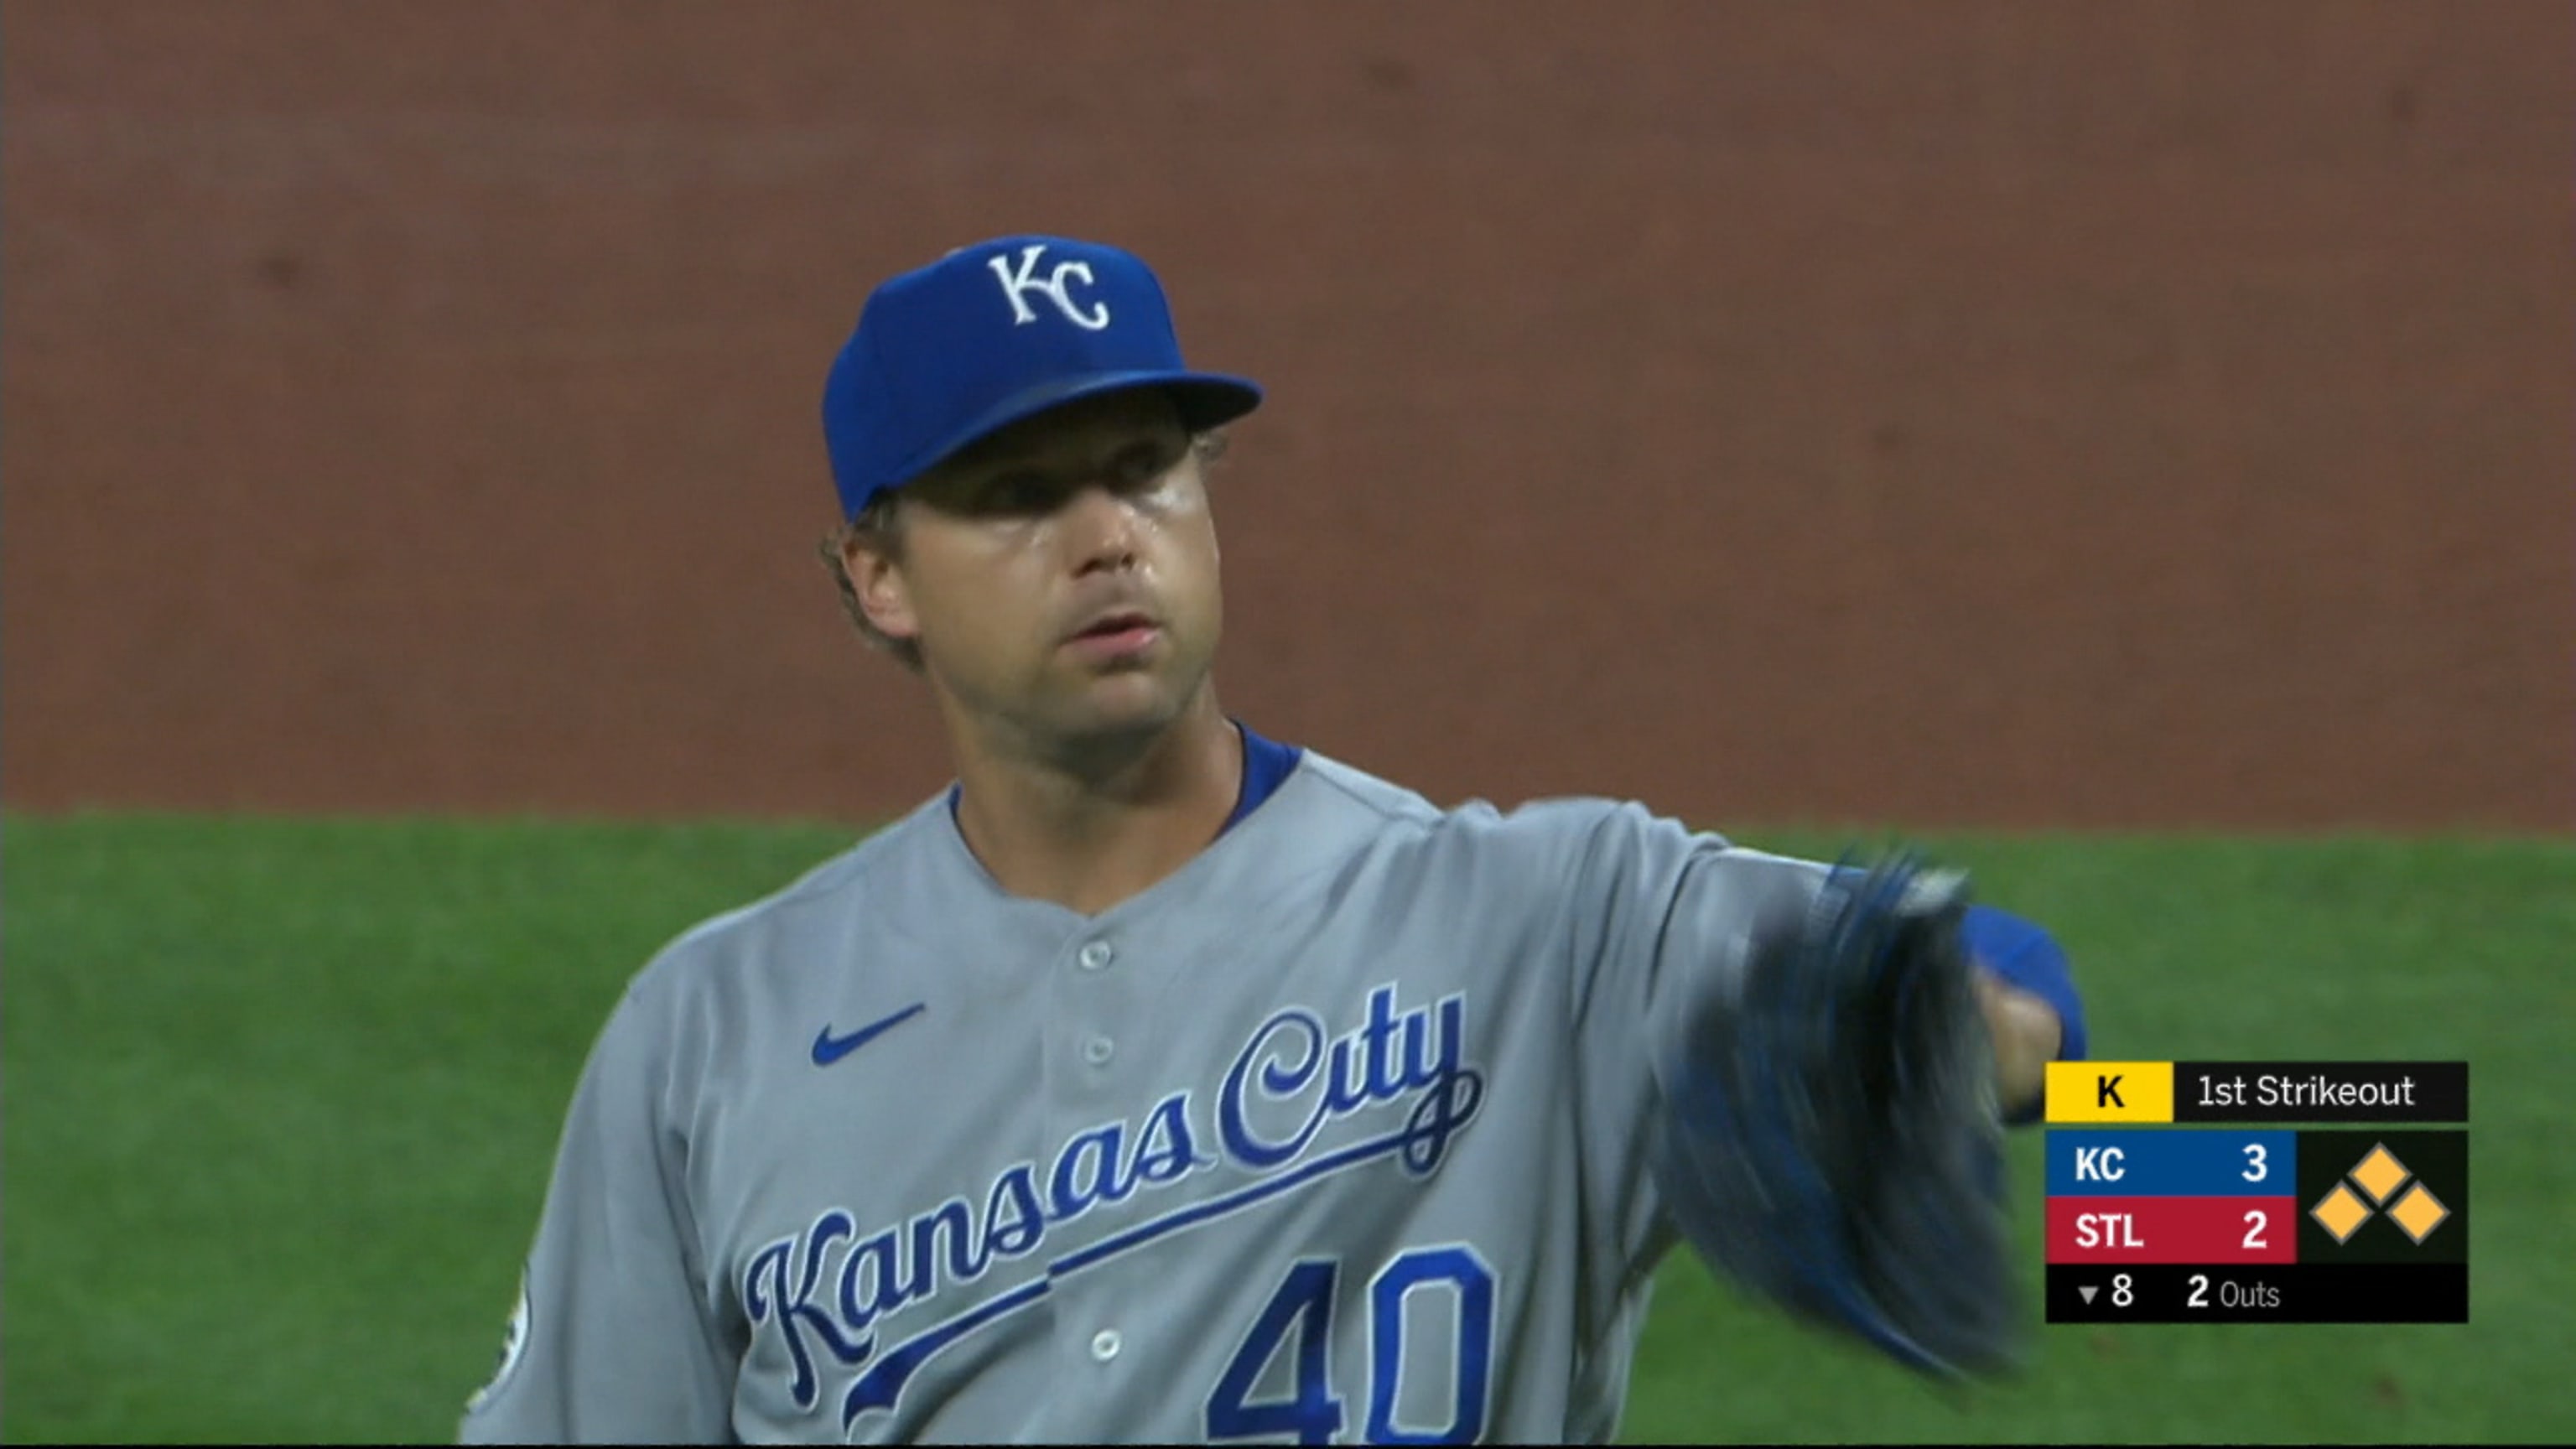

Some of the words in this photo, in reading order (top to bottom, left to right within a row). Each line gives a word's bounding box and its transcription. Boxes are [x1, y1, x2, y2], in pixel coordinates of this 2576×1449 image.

[987, 244, 1109, 330] KC
[742, 1088, 1216, 1410] Kansas
[1216, 979, 1484, 1176] City
[1203, 1242, 1498, 1446] 40
